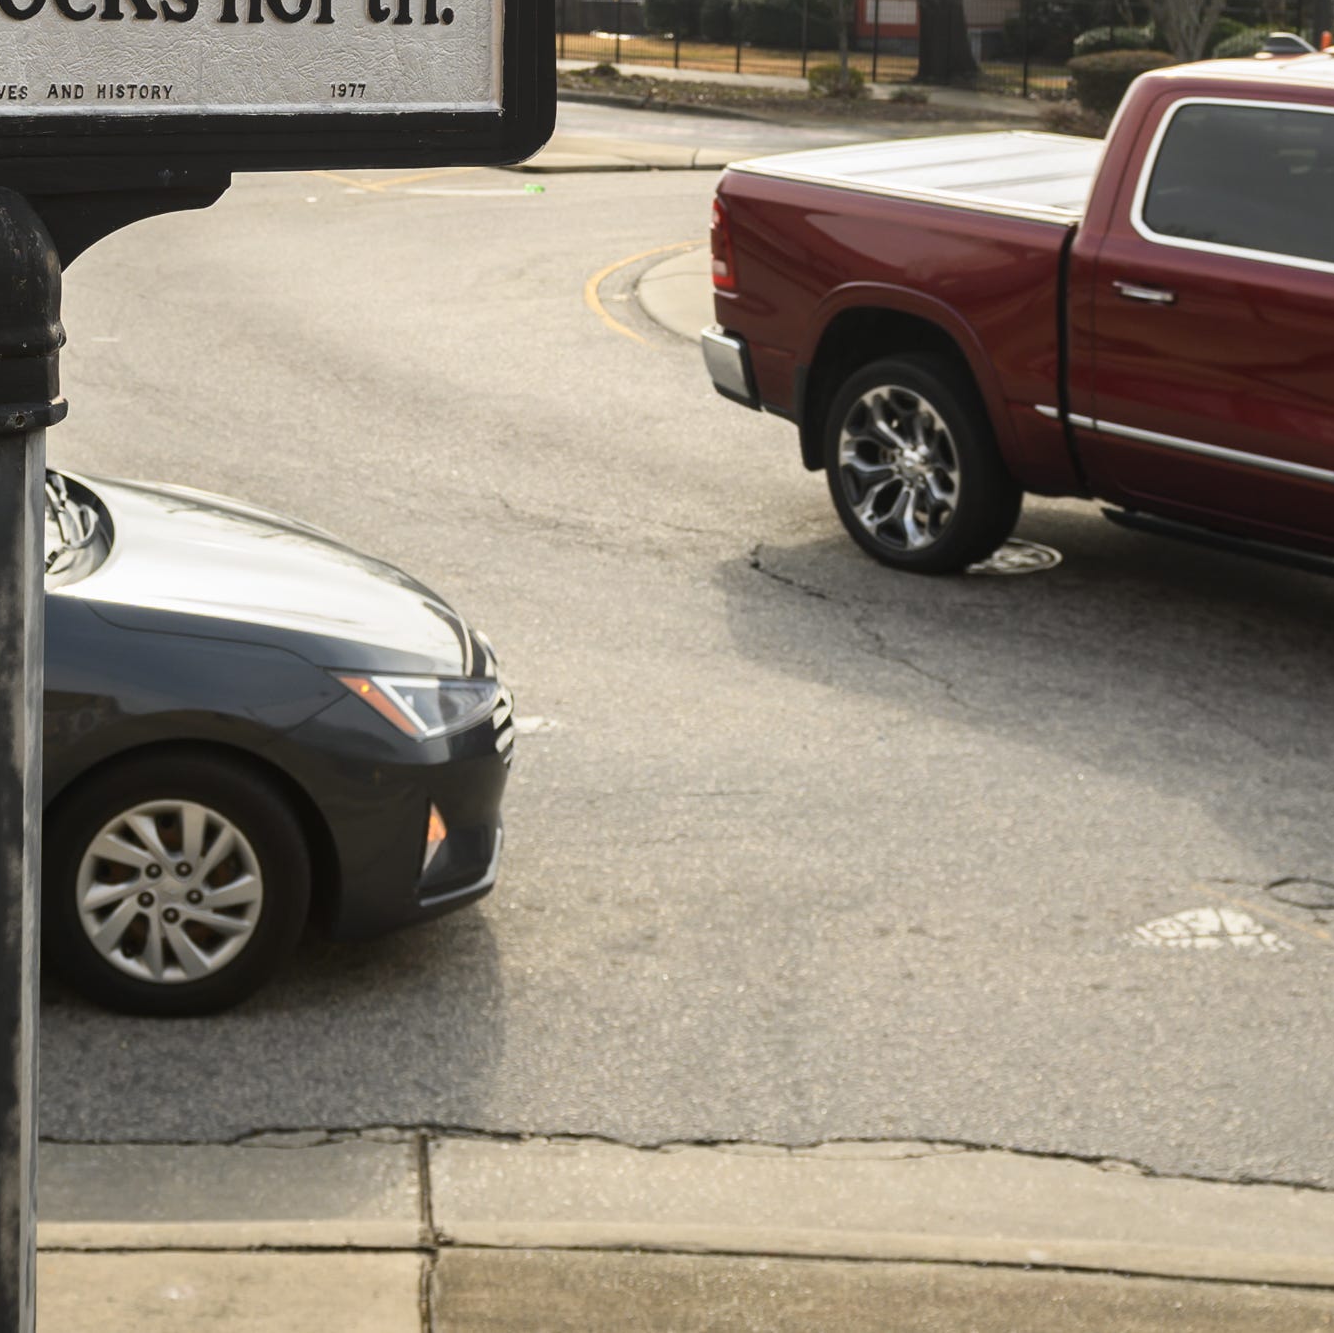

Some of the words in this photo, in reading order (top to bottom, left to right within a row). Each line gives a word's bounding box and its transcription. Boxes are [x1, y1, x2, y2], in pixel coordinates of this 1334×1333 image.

[46, 83, 85, 100] AND
[97, 84, 175, 101] HISTORY
[329, 82, 367, 99] 1977
